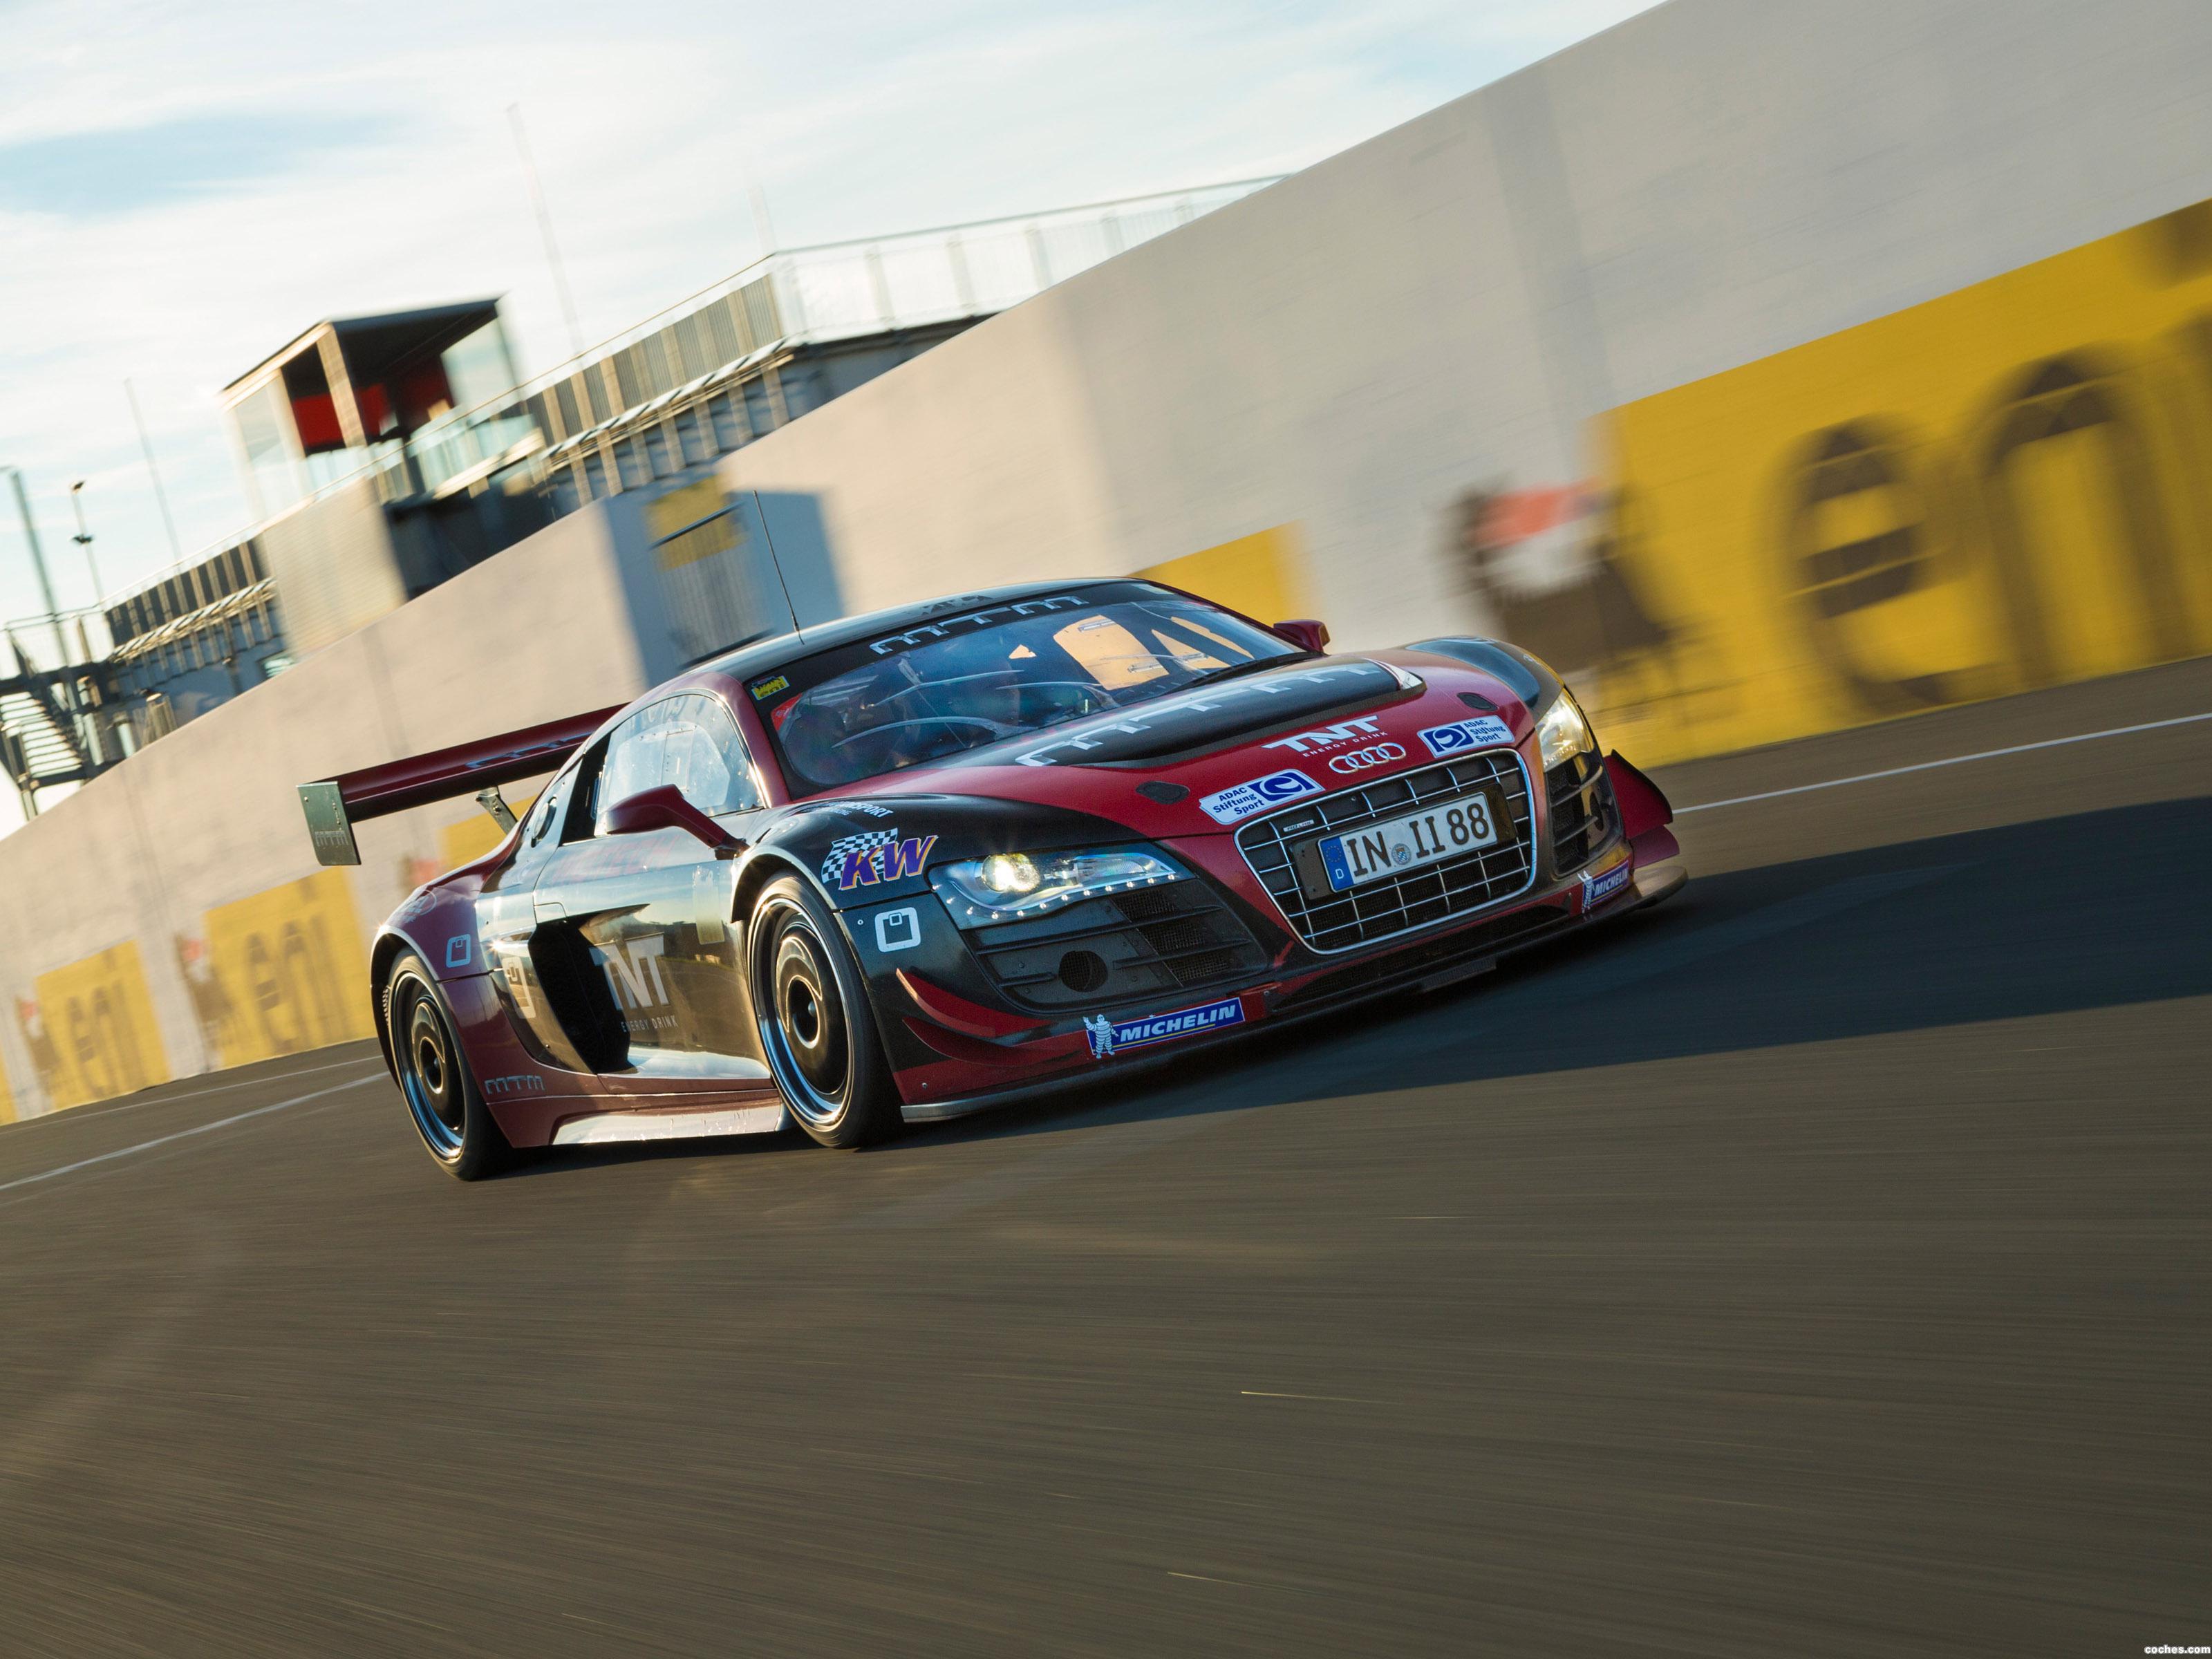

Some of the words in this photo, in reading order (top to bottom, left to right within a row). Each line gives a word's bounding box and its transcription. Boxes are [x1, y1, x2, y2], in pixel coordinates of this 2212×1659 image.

[1260, 715, 1380, 752] TNT
[1463, 720, 1488, 729] ADAC
[1470, 725, 1506, 735] Stiftung
[1302, 741, 1347, 758] ENERGY
[1352, 731, 1388, 743] DRINK
[1476, 733, 1501, 743] Sport
[1213, 794, 1257, 814] Stiftung
[1219, 787, 1248, 802] ADAC
[1234, 799, 1265, 816] Sport
[1347, 831, 1392, 877] IN
[1409, 816, 1446, 859] II
[1447, 803, 1489, 845] 88
[838, 835, 939, 890] KW
[1335, 868, 1344, 879] D
[1594, 868, 1628, 897] MICHELIN
[589, 932, 670, 1011] TNT
[621, 1018, 650, 1033] ENERGY
[651, 1015, 678, 1029] DRINK
[1121, 1004, 1236, 1042] MICHELIN
